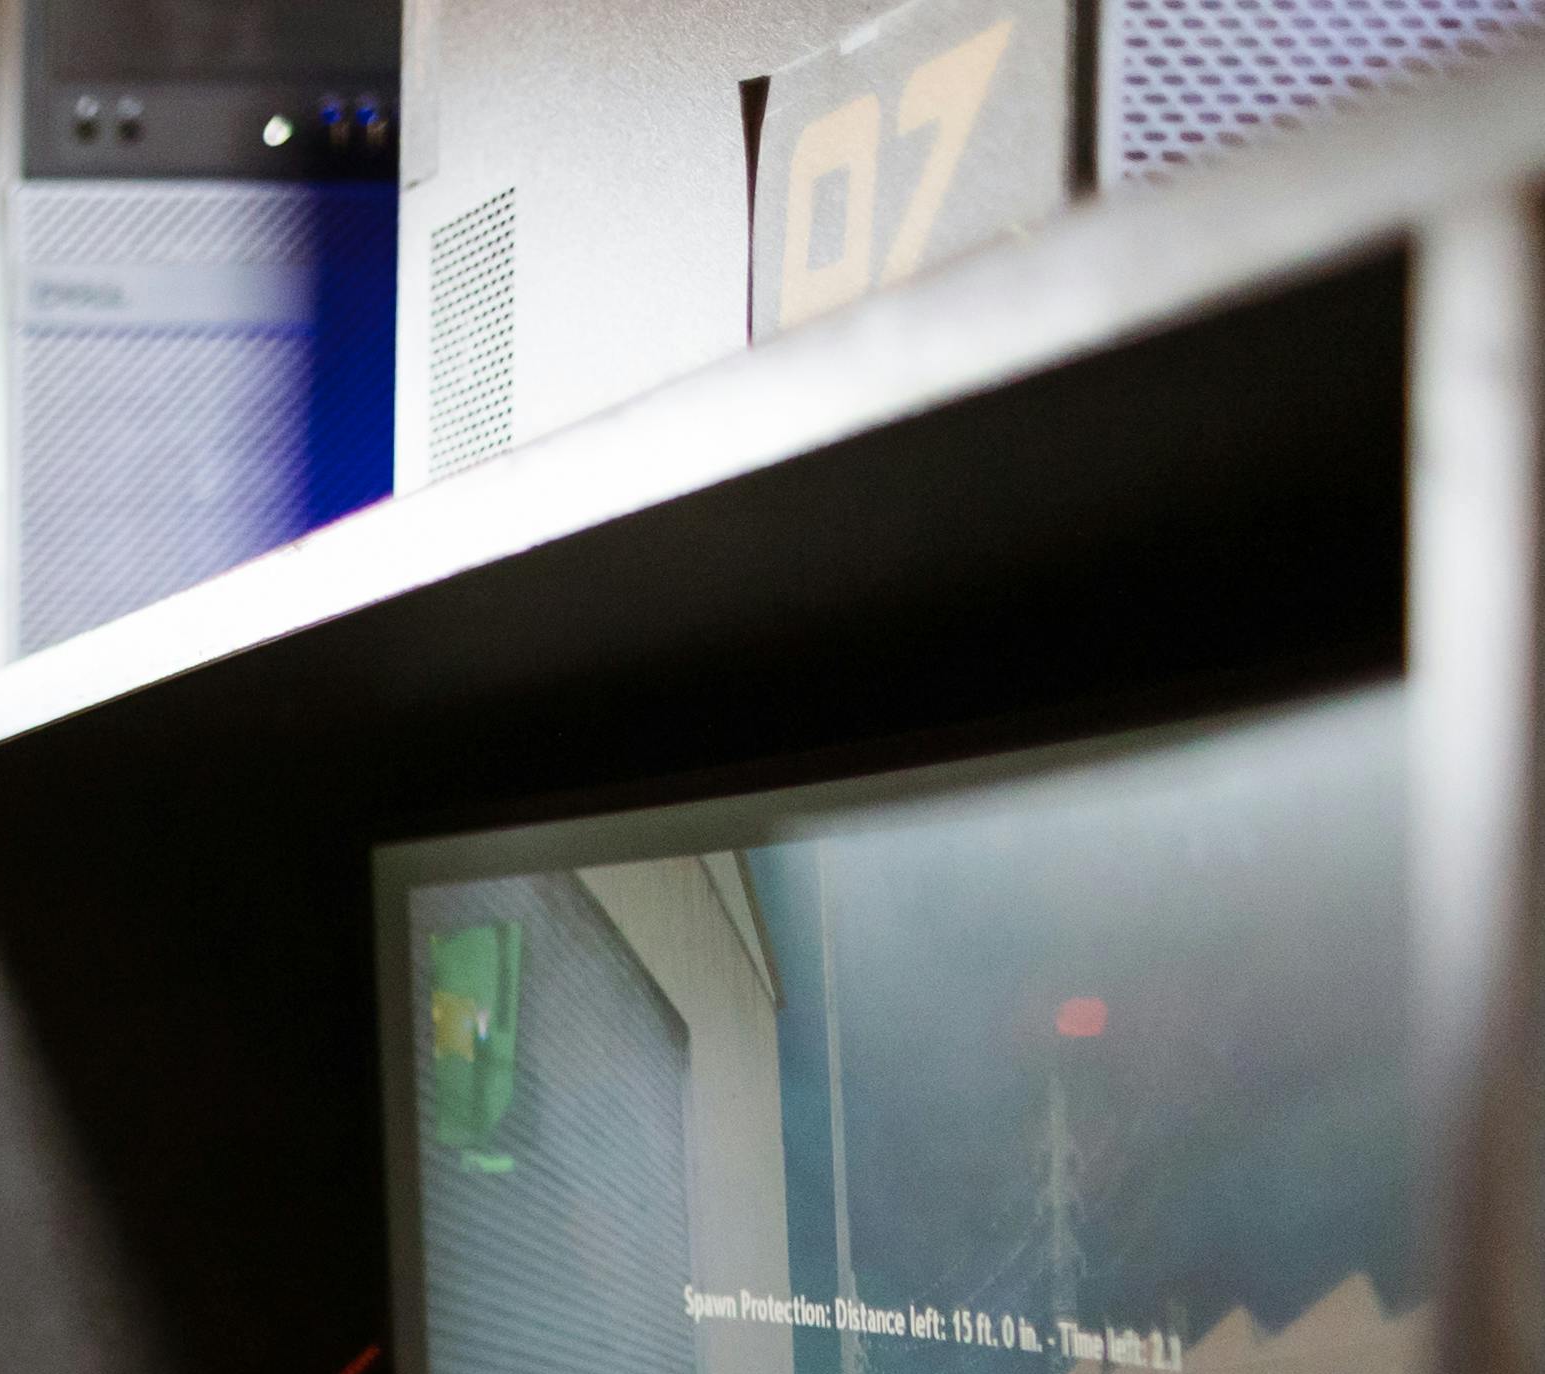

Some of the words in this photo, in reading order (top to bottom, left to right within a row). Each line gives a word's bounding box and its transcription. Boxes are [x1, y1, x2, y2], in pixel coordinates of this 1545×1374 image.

[778, 18, 1014, 332] 07
[684, 1284, 737, 1324] Spawn
[739, 1289, 831, 1328] Protection:
[835, 1298, 906, 1336] Distance
[910, 1304, 946, 1341] left:
[953, 1309, 973, 1344] 15
[1058, 1321, 1105, 1361] Time
